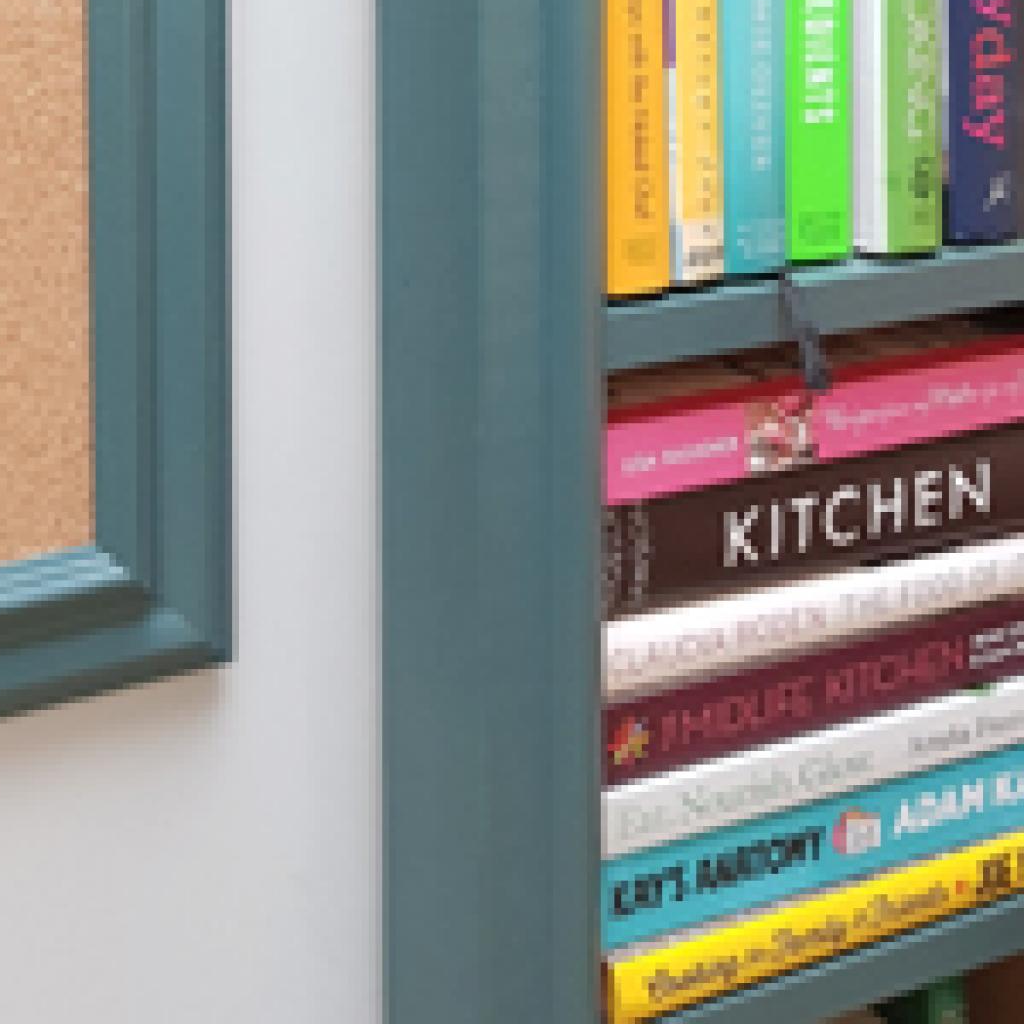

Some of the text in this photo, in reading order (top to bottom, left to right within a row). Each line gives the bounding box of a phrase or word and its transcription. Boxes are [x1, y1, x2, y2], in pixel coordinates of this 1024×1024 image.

[721, 460, 994, 569] KITCHEN
[890, 779, 987, 839] ADAM
[611, 866, 688, 921] KAY'S
[974, 851, 1012, 900] JOE
